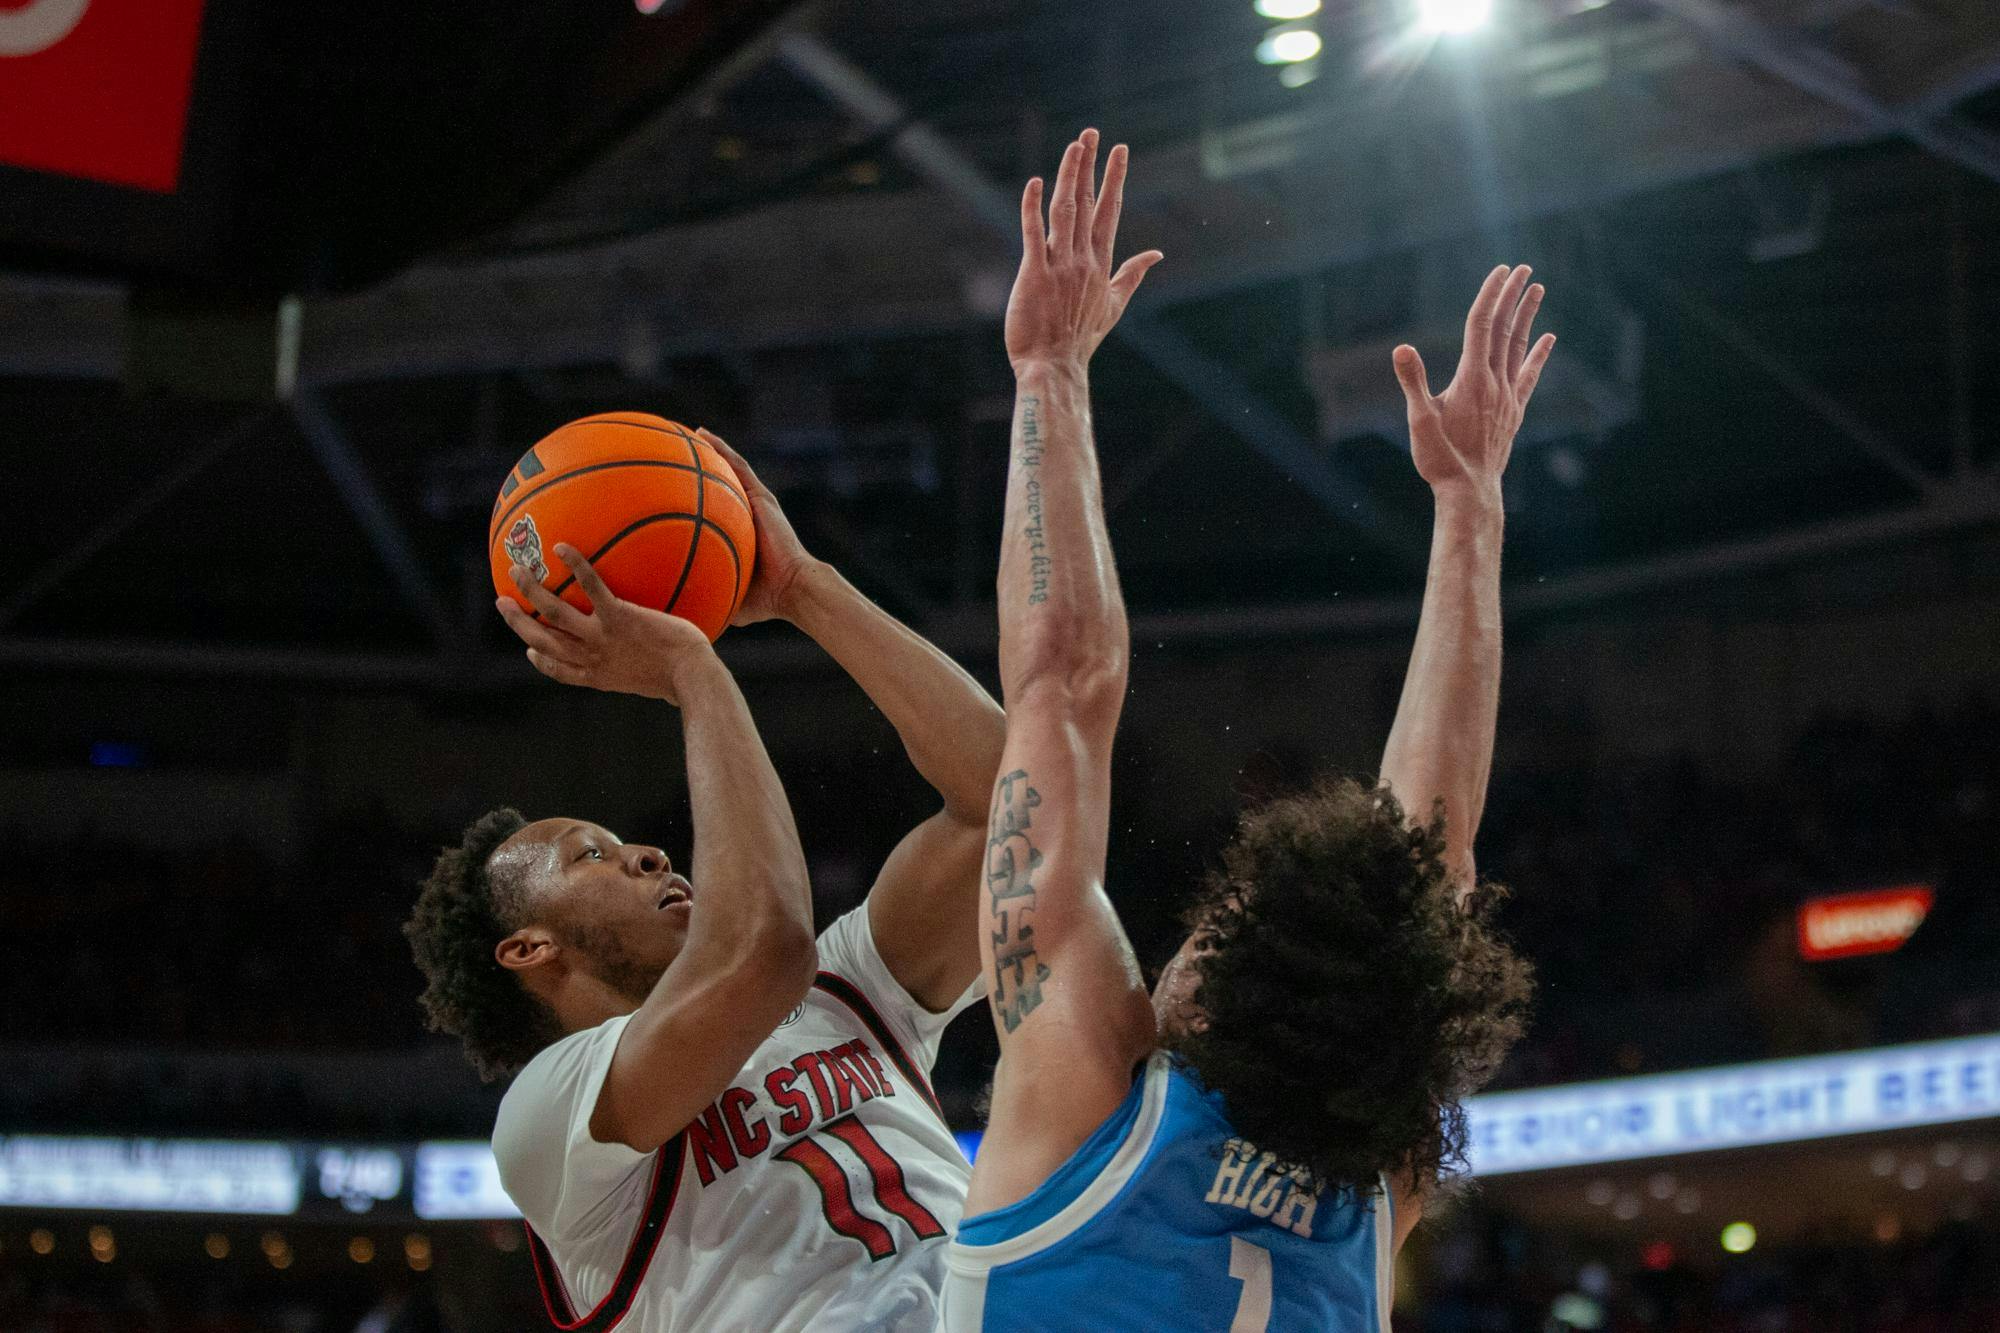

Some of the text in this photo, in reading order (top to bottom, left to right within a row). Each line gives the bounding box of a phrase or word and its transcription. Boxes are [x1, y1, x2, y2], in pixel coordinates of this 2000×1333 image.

[1022, 394, 1043, 467] family
[1026, 481, 1051, 605] everything
[688, 1038, 896, 1188] NC STATE
[1478, 1060, 2000, 1161] ERIOR LIGHT BEE
[771, 1112, 948, 1263] 11
[1229, 1235, 1273, 1333] 1
